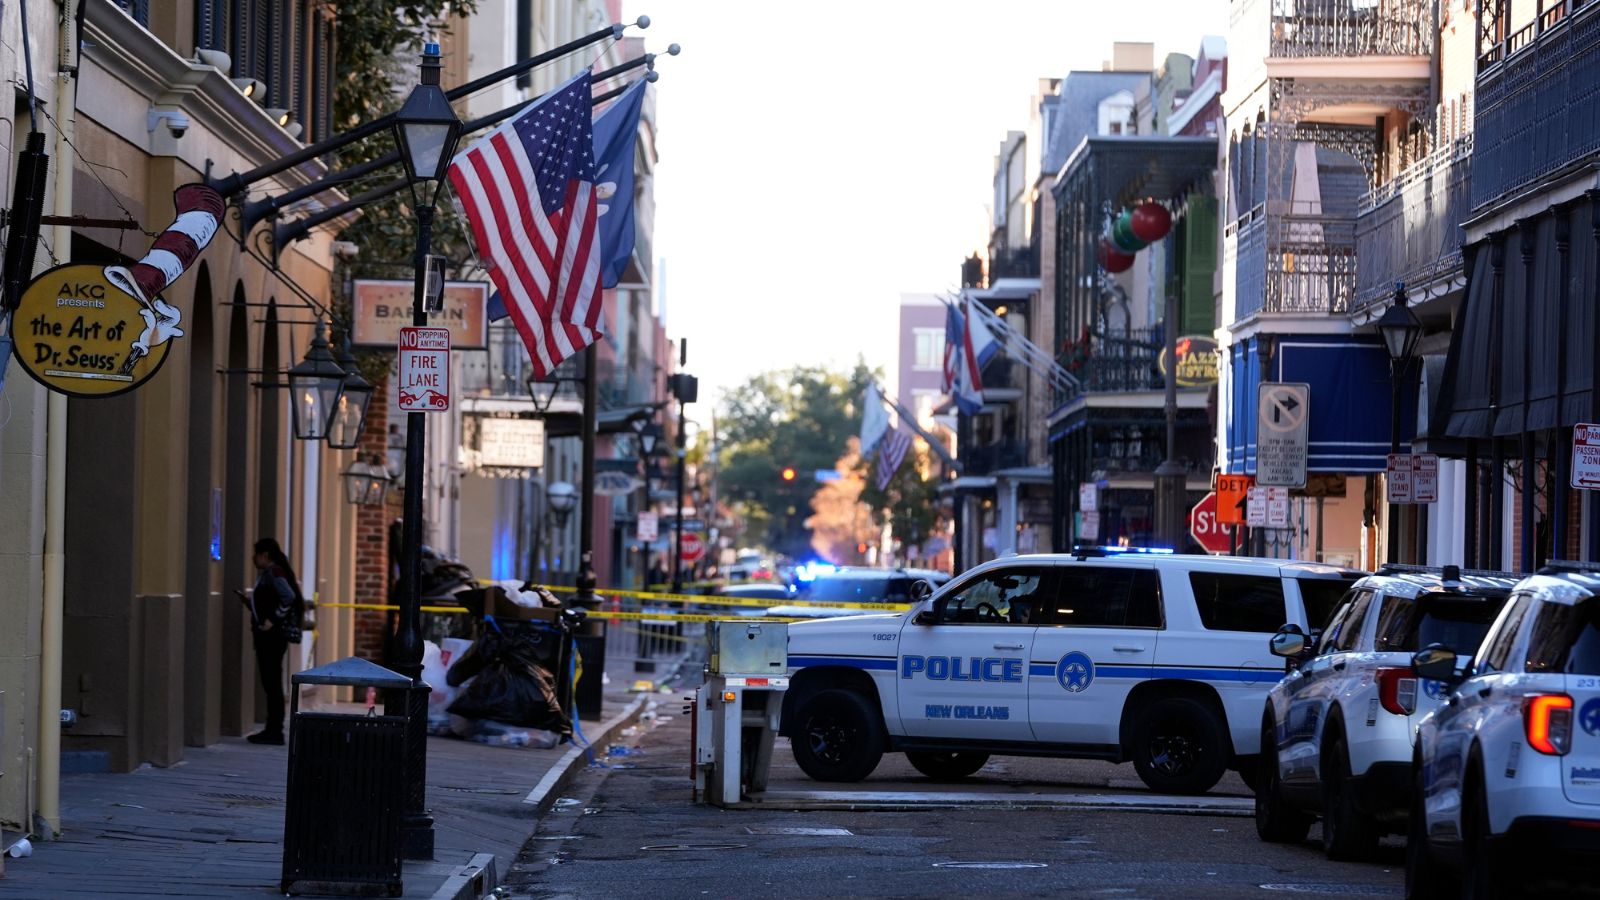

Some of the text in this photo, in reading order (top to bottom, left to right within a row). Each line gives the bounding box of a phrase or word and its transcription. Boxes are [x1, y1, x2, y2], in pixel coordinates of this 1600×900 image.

[58, 283, 105, 299] AKG
[57, 298, 105, 308] presents
[30, 314, 126, 340] the Art of
[401, 331, 448, 347] NO STOPPING
[420, 340, 446, 348] ANYTIME
[34, 343, 62, 367] Dr.
[411, 355, 438, 369] FIRE
[408, 373, 440, 387] LANE
[1575, 427, 1587, 441] NO
[1576, 446, 1600, 456] PASSEN
[1220, 479, 1255, 492] DETO
[1196, 511, 1231, 535] ST
[872, 633, 897, 641] 18027
[902, 654, 1024, 683] POLICE
[925, 704, 1010, 720] NEW ORLEANS
